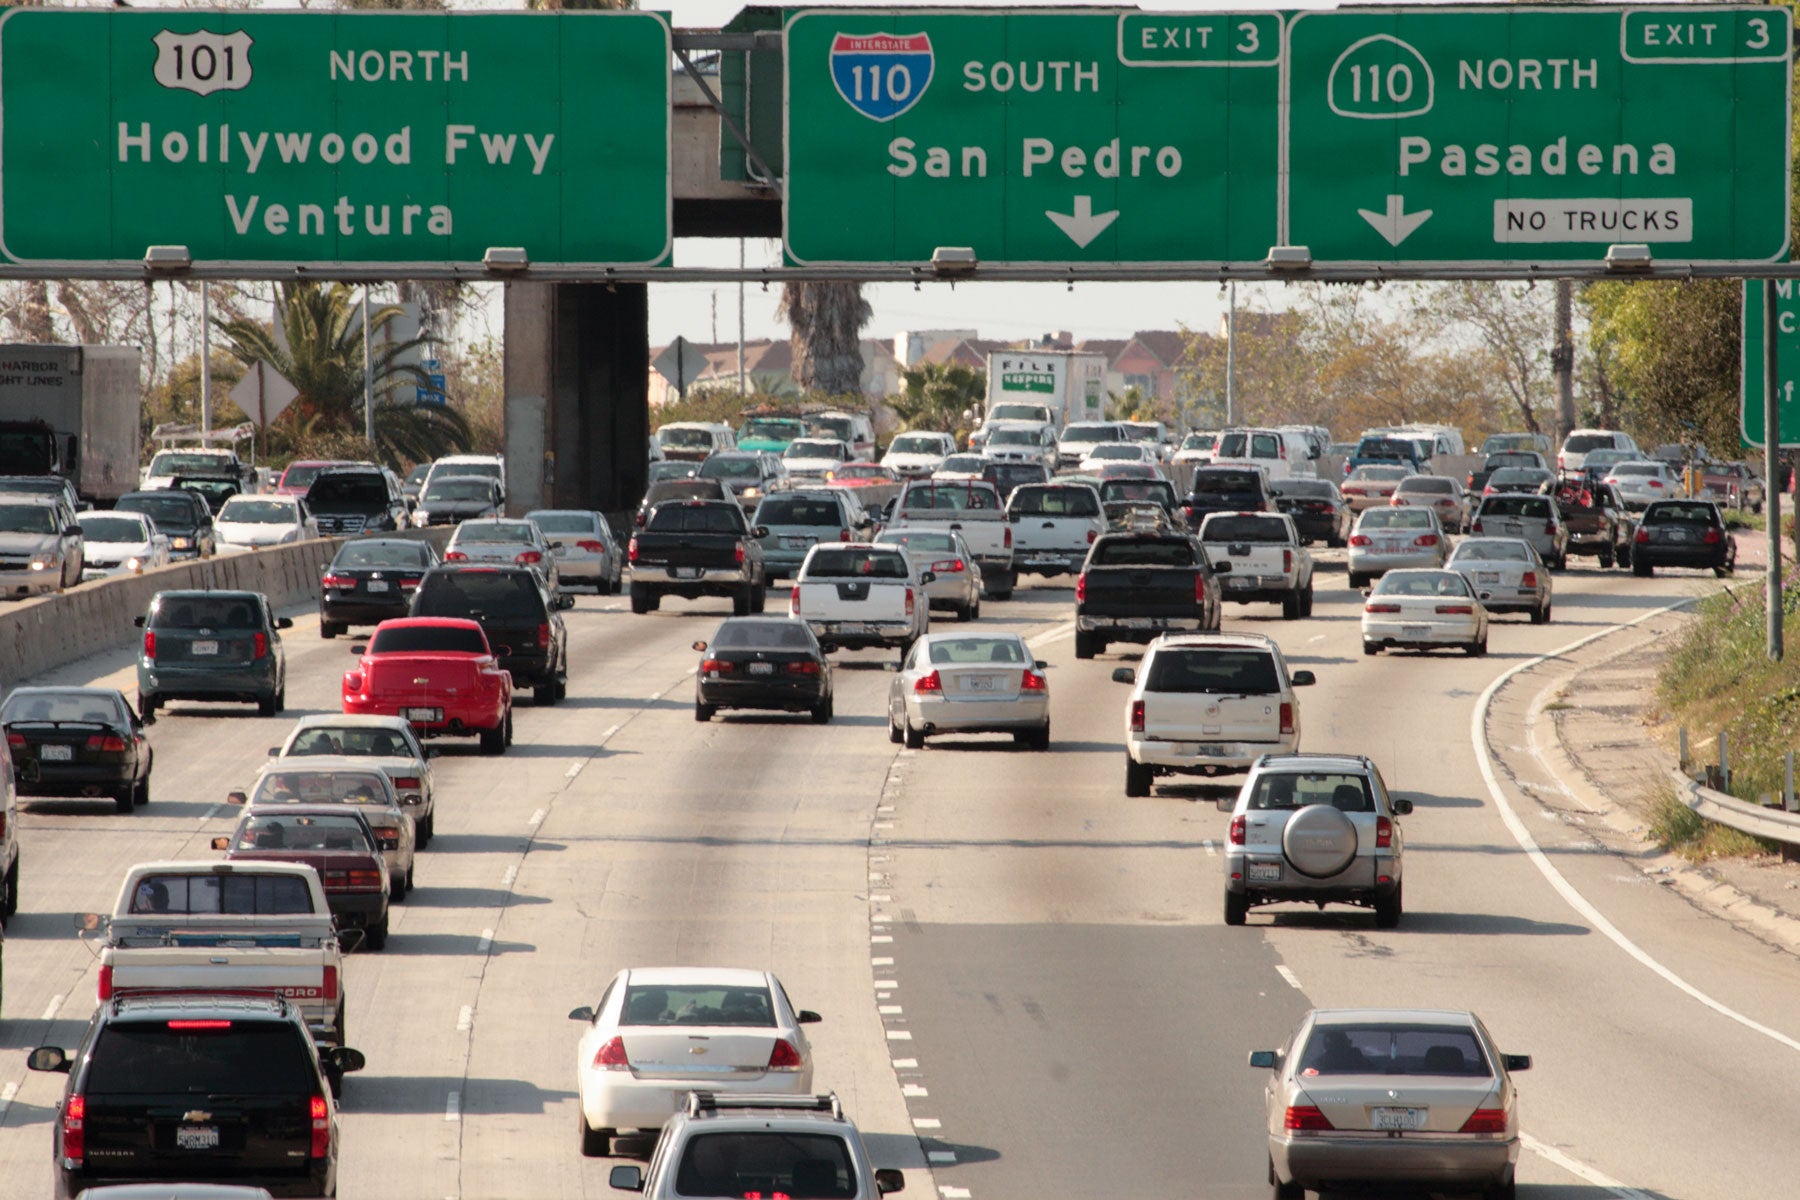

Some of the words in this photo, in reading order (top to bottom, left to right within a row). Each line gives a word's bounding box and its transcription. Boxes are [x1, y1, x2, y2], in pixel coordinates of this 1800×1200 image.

[850, 40, 910, 49] INTERSTATE
[1142, 27, 1213, 49] EXIT
[1236, 22, 1260, 54] 3
[1645, 24, 1717, 45] EXIT
[1746, 18, 1770, 49] 3
[174, 45, 234, 81] 101
[330, 50, 468, 82] NORTH
[963, 61, 1099, 92] SOUTH
[1459, 58, 1598, 90] NORTH
[852, 64, 911, 102] 110
[1350, 64, 1413, 103] 110
[118, 122, 411, 173] Hollywood
[445, 124, 555, 175] Fwy
[887, 137, 987, 178] San
[1022, 137, 1182, 178] Pedro
[1399, 136, 1676, 177] Pasadena
[224, 194, 453, 236] Ventura
[1507, 211, 1546, 231] NO
[1563, 211, 1679, 231] TRUCKS
[2, 361, 58, 371] HARBOR
[26, 376, 63, 386] LINES
[1002, 360, 1055, 372] FILE
